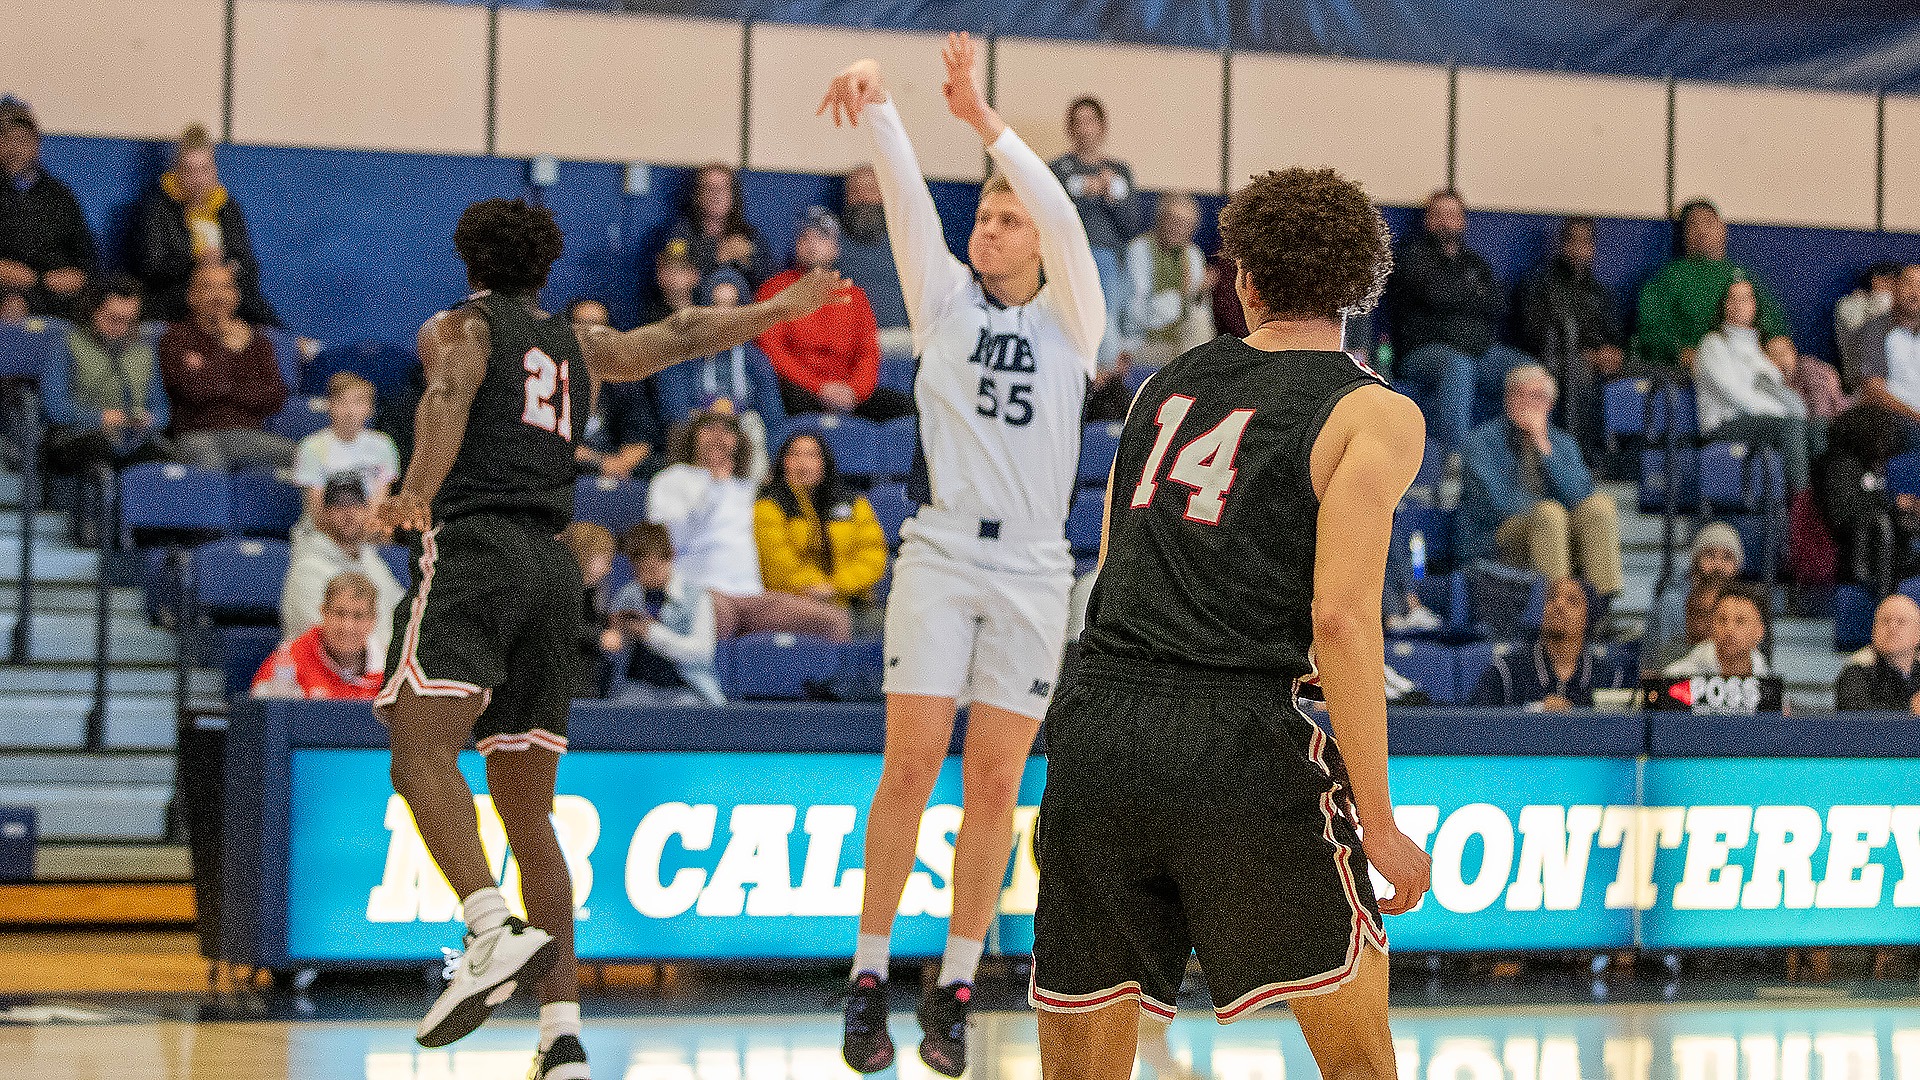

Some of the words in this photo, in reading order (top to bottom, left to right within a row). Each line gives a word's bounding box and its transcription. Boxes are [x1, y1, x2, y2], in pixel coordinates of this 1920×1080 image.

[521, 346, 573, 442] 21
[976, 377, 1033, 426] 55
[1129, 392, 1256, 527] 14
